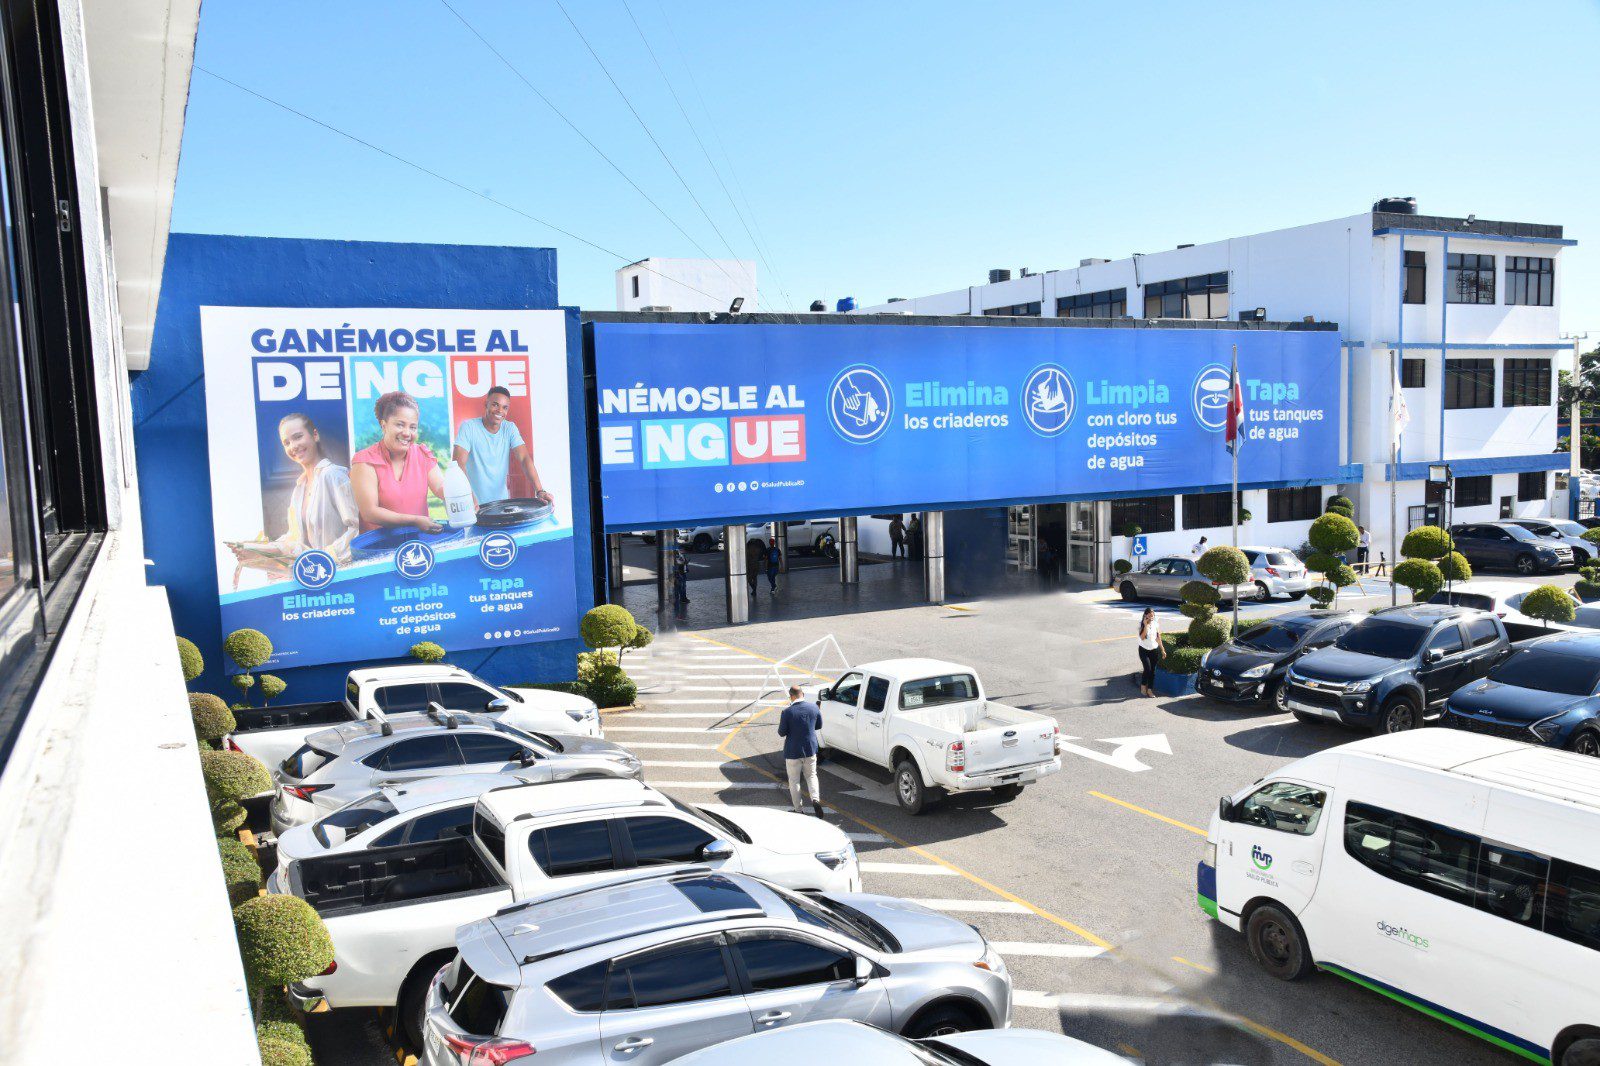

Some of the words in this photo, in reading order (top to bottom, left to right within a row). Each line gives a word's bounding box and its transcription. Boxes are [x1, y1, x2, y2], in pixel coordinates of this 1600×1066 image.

[251, 323, 476, 353] GANÉMOSLE
[485, 329, 529, 352] AL
[256, 361, 527, 401] DENGUE
[599, 383, 757, 413] NÉMOSLE
[766, 384, 805, 409] AL
[904, 382, 1009, 408] Elimina
[1086, 379, 1169, 409] Limpia
[1246, 379, 1299, 403] Tapa
[904, 414, 929, 430] los
[933, 411, 1009, 430] criaderos
[1087, 413, 1114, 427] con
[1117, 411, 1151, 427] cloro
[1155, 412, 1178, 426] tus
[1249, 408, 1270, 422] tus
[1273, 407, 1324, 424] tanques
[1087, 431, 1157, 450] depósitos
[1249, 424, 1267, 440] de
[1270, 426, 1299, 442] agua
[1087, 453, 1106, 469] de
[1110, 454, 1144, 470] agua
[383, 583, 449, 602] Limpia
[479, 576, 524, 593] Tapa
[283, 592, 355, 610] Elimina
[469, 592, 486, 602] tus
[489, 590, 533, 603] tanques
[282, 611, 299, 621] los
[302, 606, 355, 619] criaderos
[391, 603, 411, 613] con
[414, 601, 443, 612] cloro
[480, 602, 495, 612] de
[497, 601, 523, 614] agua
[379, 616, 398, 626] tus
[400, 611, 456, 626] depósitos
[396, 625, 411, 635] de
[414, 623, 441, 635] agua
